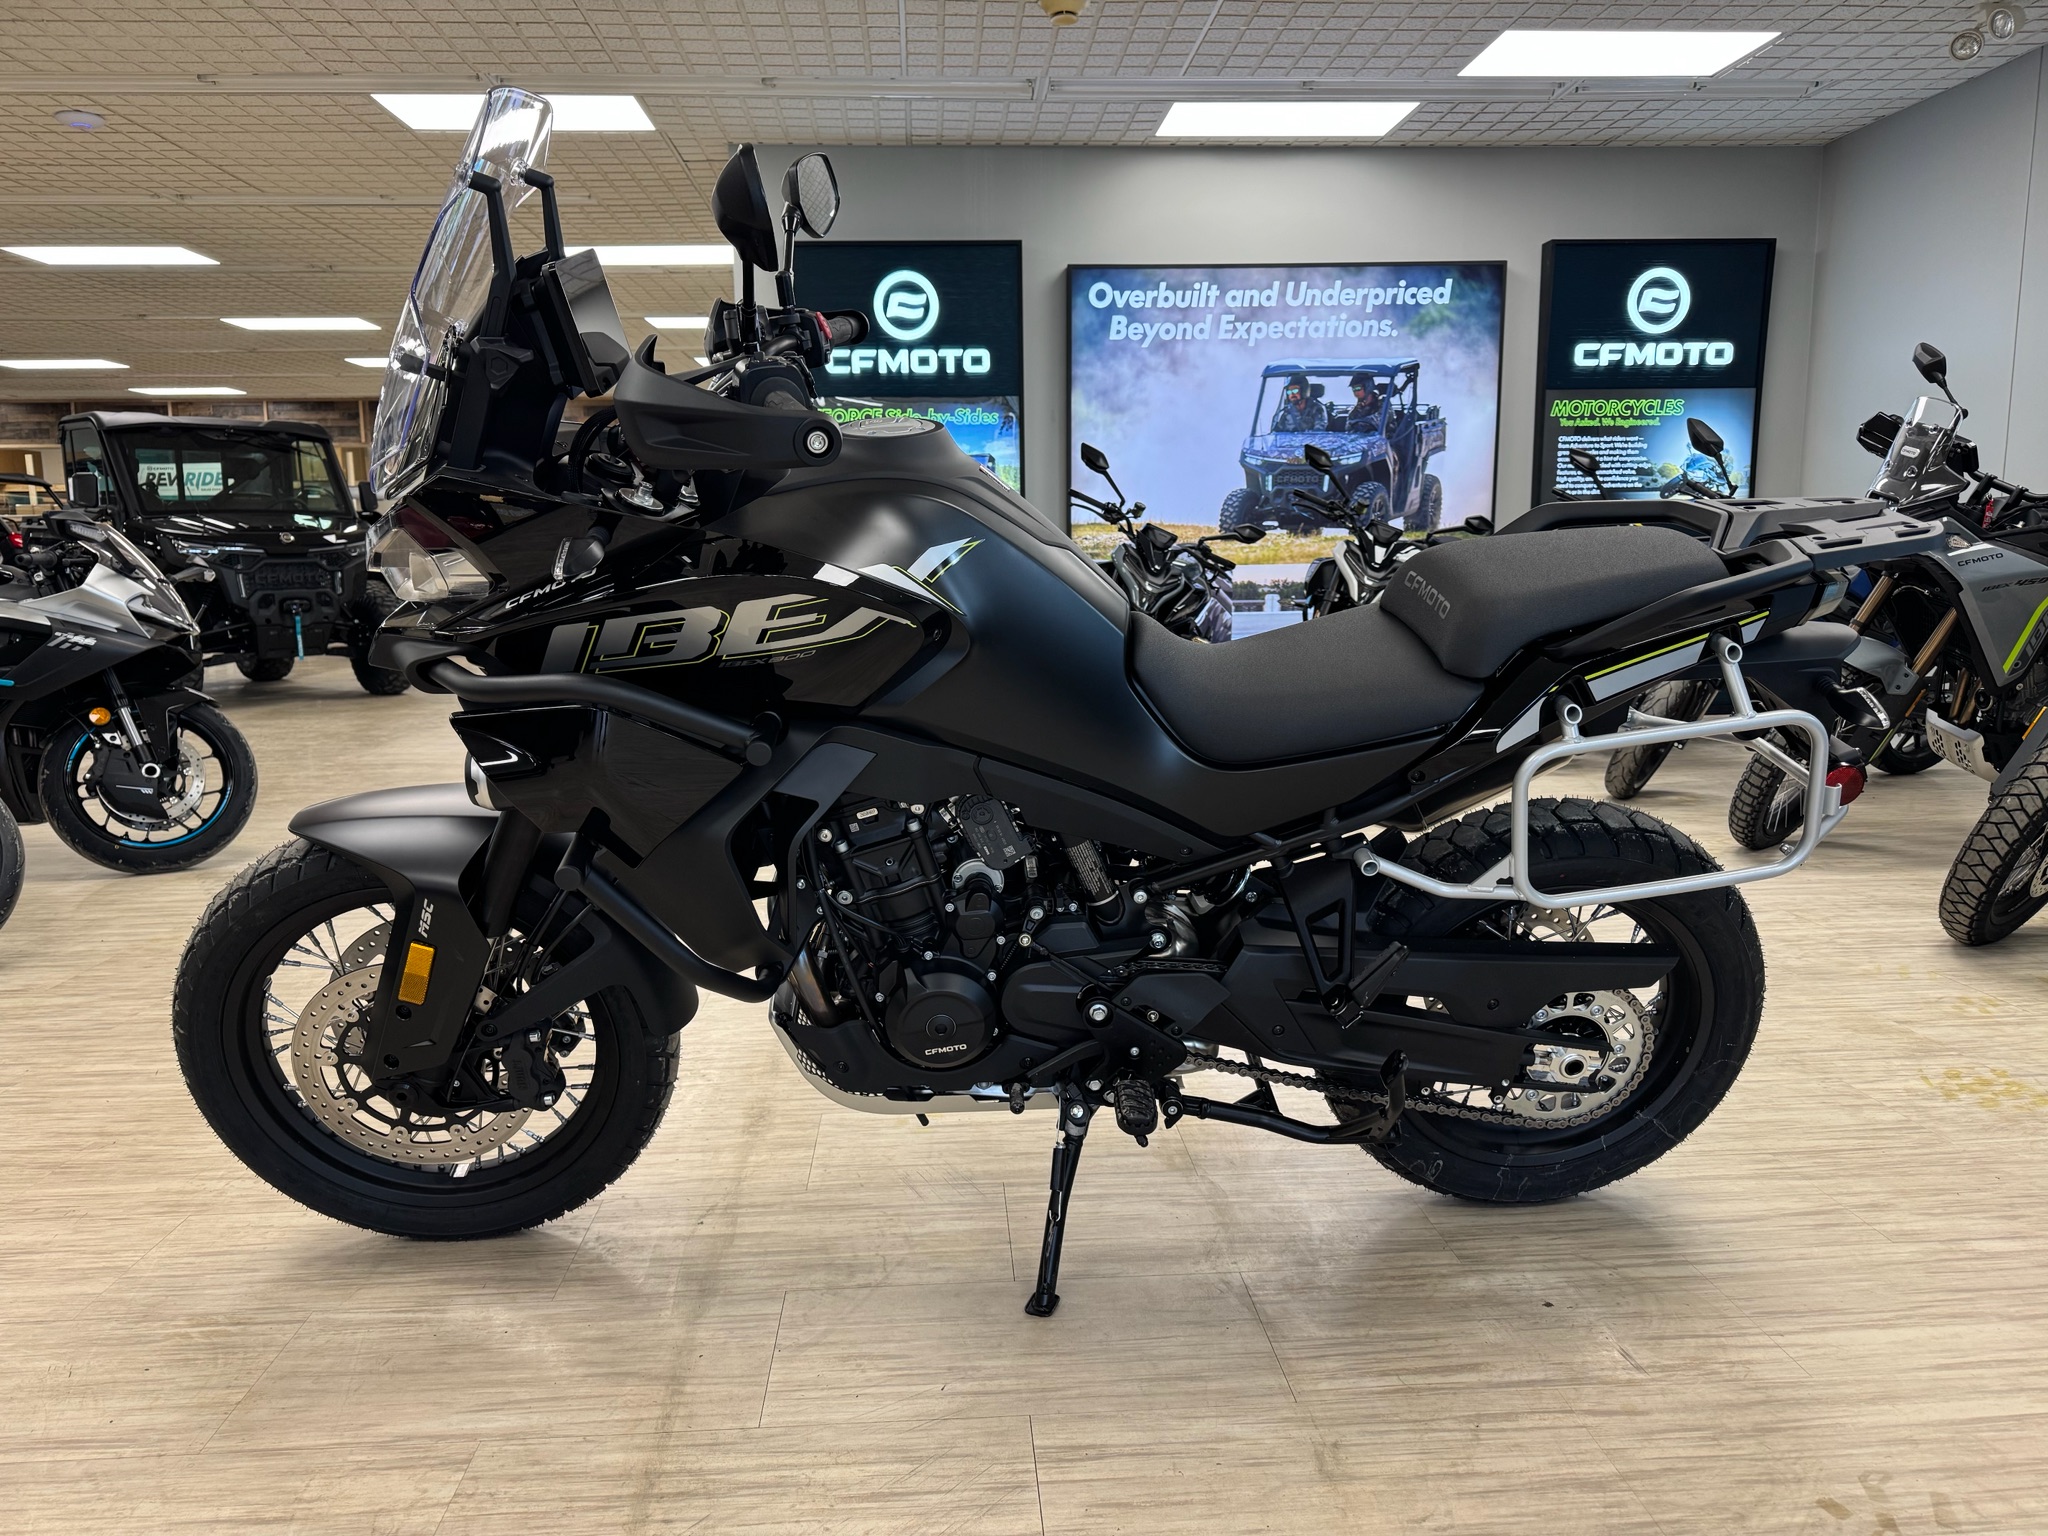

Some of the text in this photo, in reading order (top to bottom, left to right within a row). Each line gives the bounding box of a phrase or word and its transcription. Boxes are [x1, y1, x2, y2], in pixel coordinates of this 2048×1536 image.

[1088, 278, 1453, 313] Overbuilt and Underpriced
[1108, 313, 1399, 348] Beyond Expectations.
[825, 348, 991, 374] CFMOTO
[1574, 342, 1735, 367] CFMOTO
[1550, 399, 1684, 417] MOTORCYCLES
[1559, 417, 1660, 428] You Asked. We Engineered.
[1957, 553, 2004, 567] CFMOTO
[1404, 570, 1451, 620] CFMOTO
[718, 649, 816, 669] IBEX 800
[418, 898, 434, 939] MSC
[924, 1043, 968, 1056] CFMOTO
